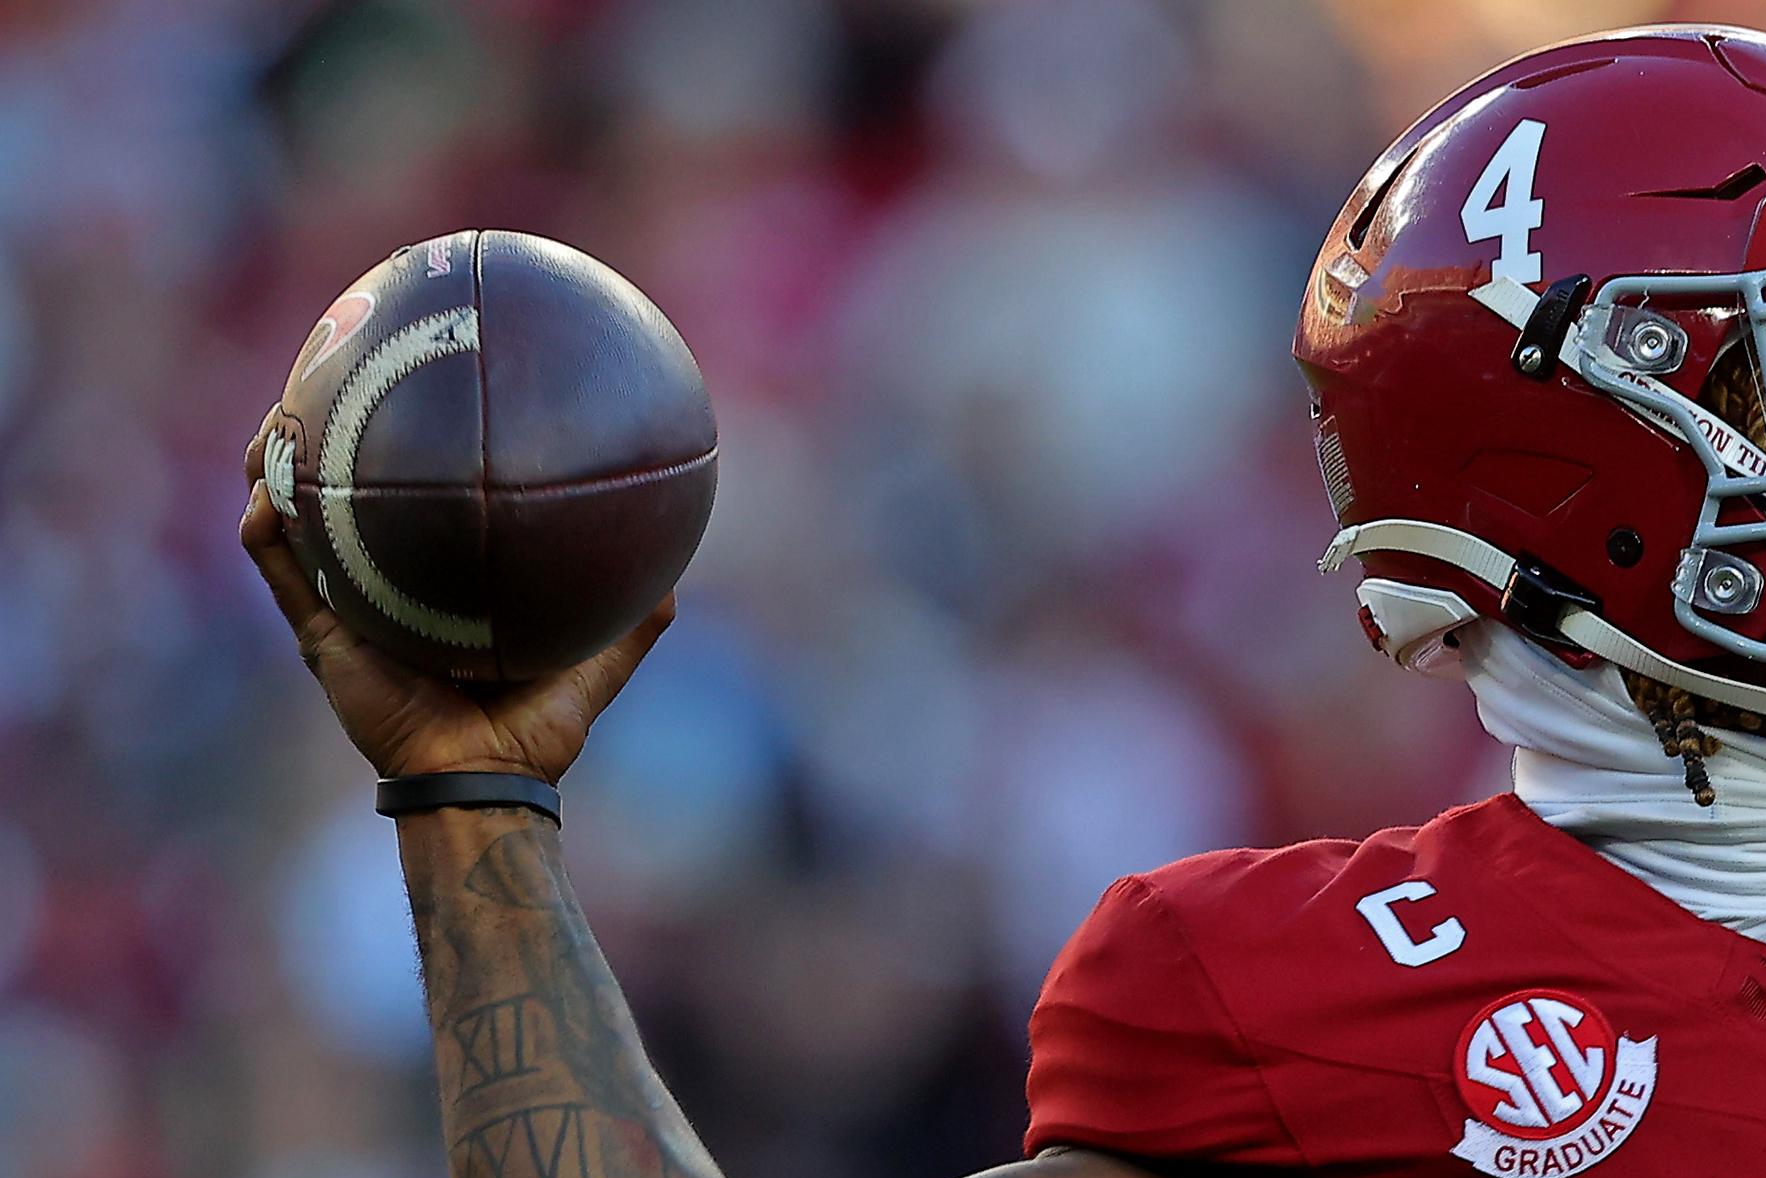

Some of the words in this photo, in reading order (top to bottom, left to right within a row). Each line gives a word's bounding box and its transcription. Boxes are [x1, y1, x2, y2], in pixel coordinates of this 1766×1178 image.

[1460, 118, 1546, 285] 4
[1354, 880, 1467, 968] C
[1466, 998, 1604, 1128] SEC
[1494, 1079, 1646, 1176] GRADUATE
